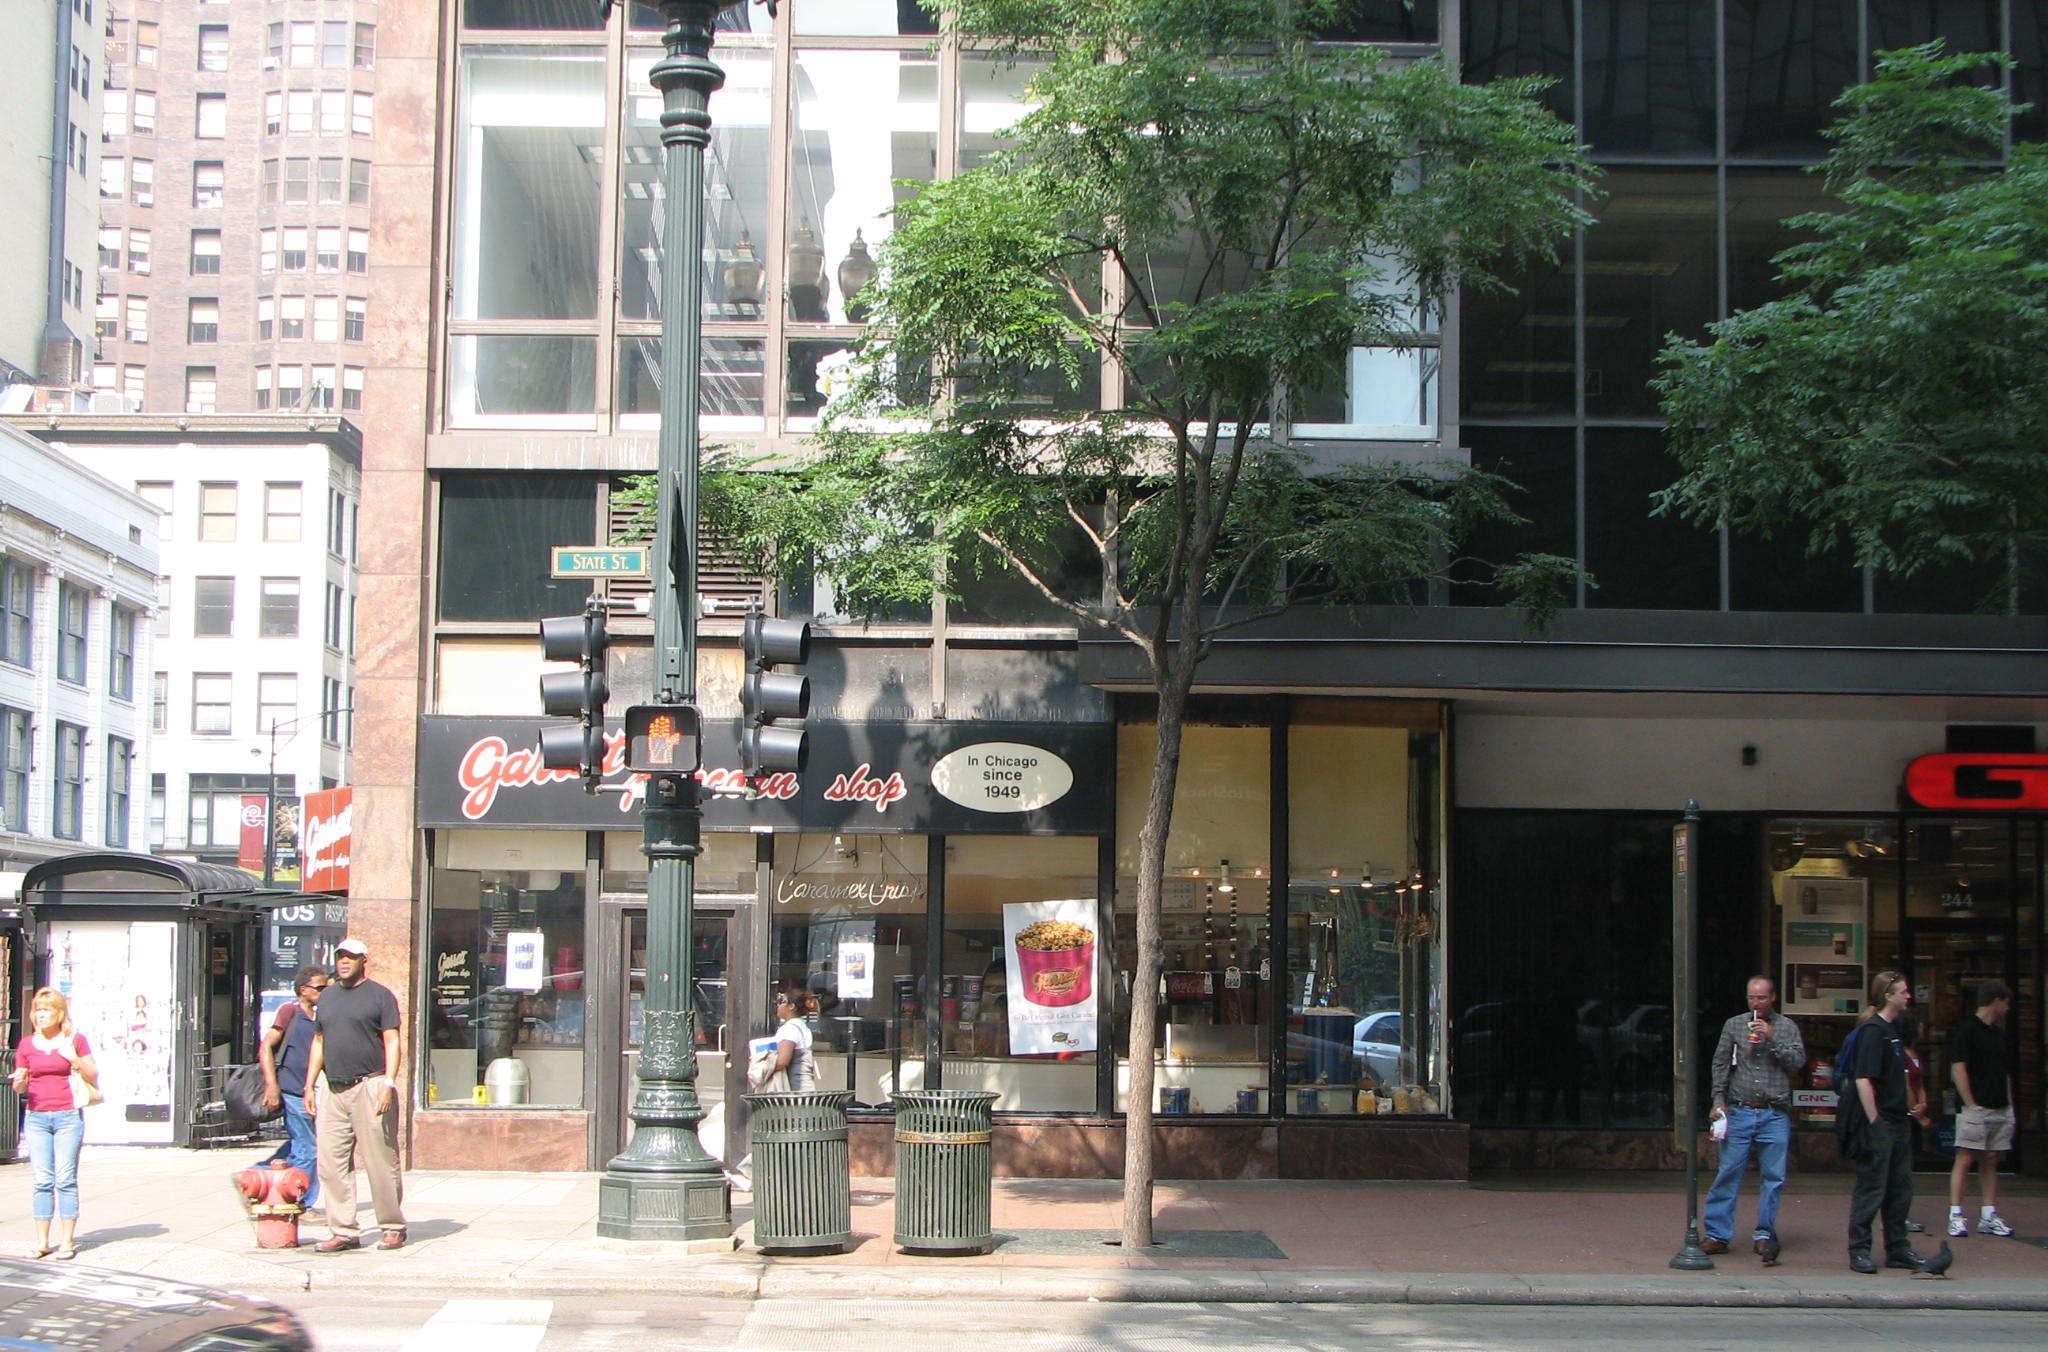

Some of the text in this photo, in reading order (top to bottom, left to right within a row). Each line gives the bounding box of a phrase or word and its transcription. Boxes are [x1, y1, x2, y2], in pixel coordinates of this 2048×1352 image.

[573, 554, 629, 570] STATE ST.
[967, 755, 1038, 768] In Chicago
[982, 769, 1023, 781] since
[824, 763, 908, 813] shop
[985, 785, 1021, 799] 1949
[1941, 893, 1974, 908] 244
[283, 936, 299, 946] 27
[1797, 1093, 1830, 1102] GNC
